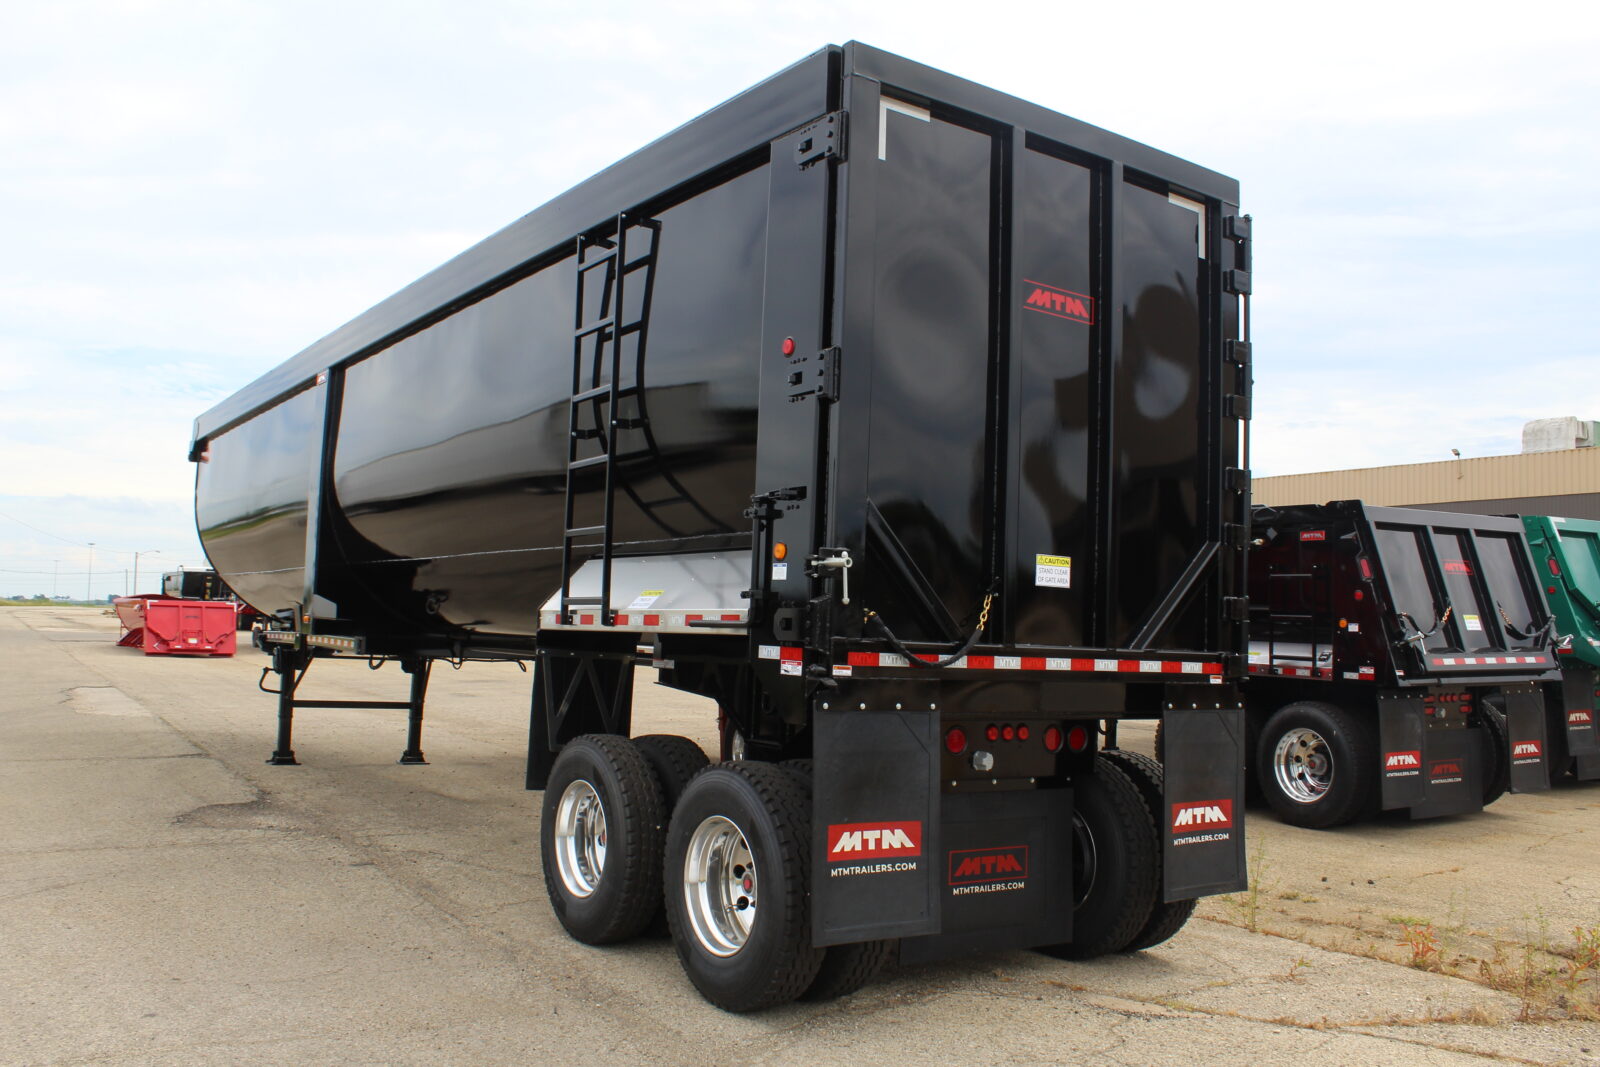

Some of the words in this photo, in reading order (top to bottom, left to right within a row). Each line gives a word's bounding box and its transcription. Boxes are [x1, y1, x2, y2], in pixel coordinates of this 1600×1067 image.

[1026, 288, 1089, 318] MTM
[1045, 557, 1070, 565] CAUTION
[1569, 712, 1590, 722] MTM
[1514, 743, 1539, 755] MTM
[1387, 754, 1418, 767] MTM
[1174, 805, 1228, 826] MTM
[832, 828, 915, 853] MTM
[1173, 832, 1230, 847] MTMTRAILERS.COM
[831, 862, 917, 877] MTMTRAILERS.COM
[954, 853, 1023, 877] MTM
[952, 881, 1025, 896] MTMTRAILERS.COM
